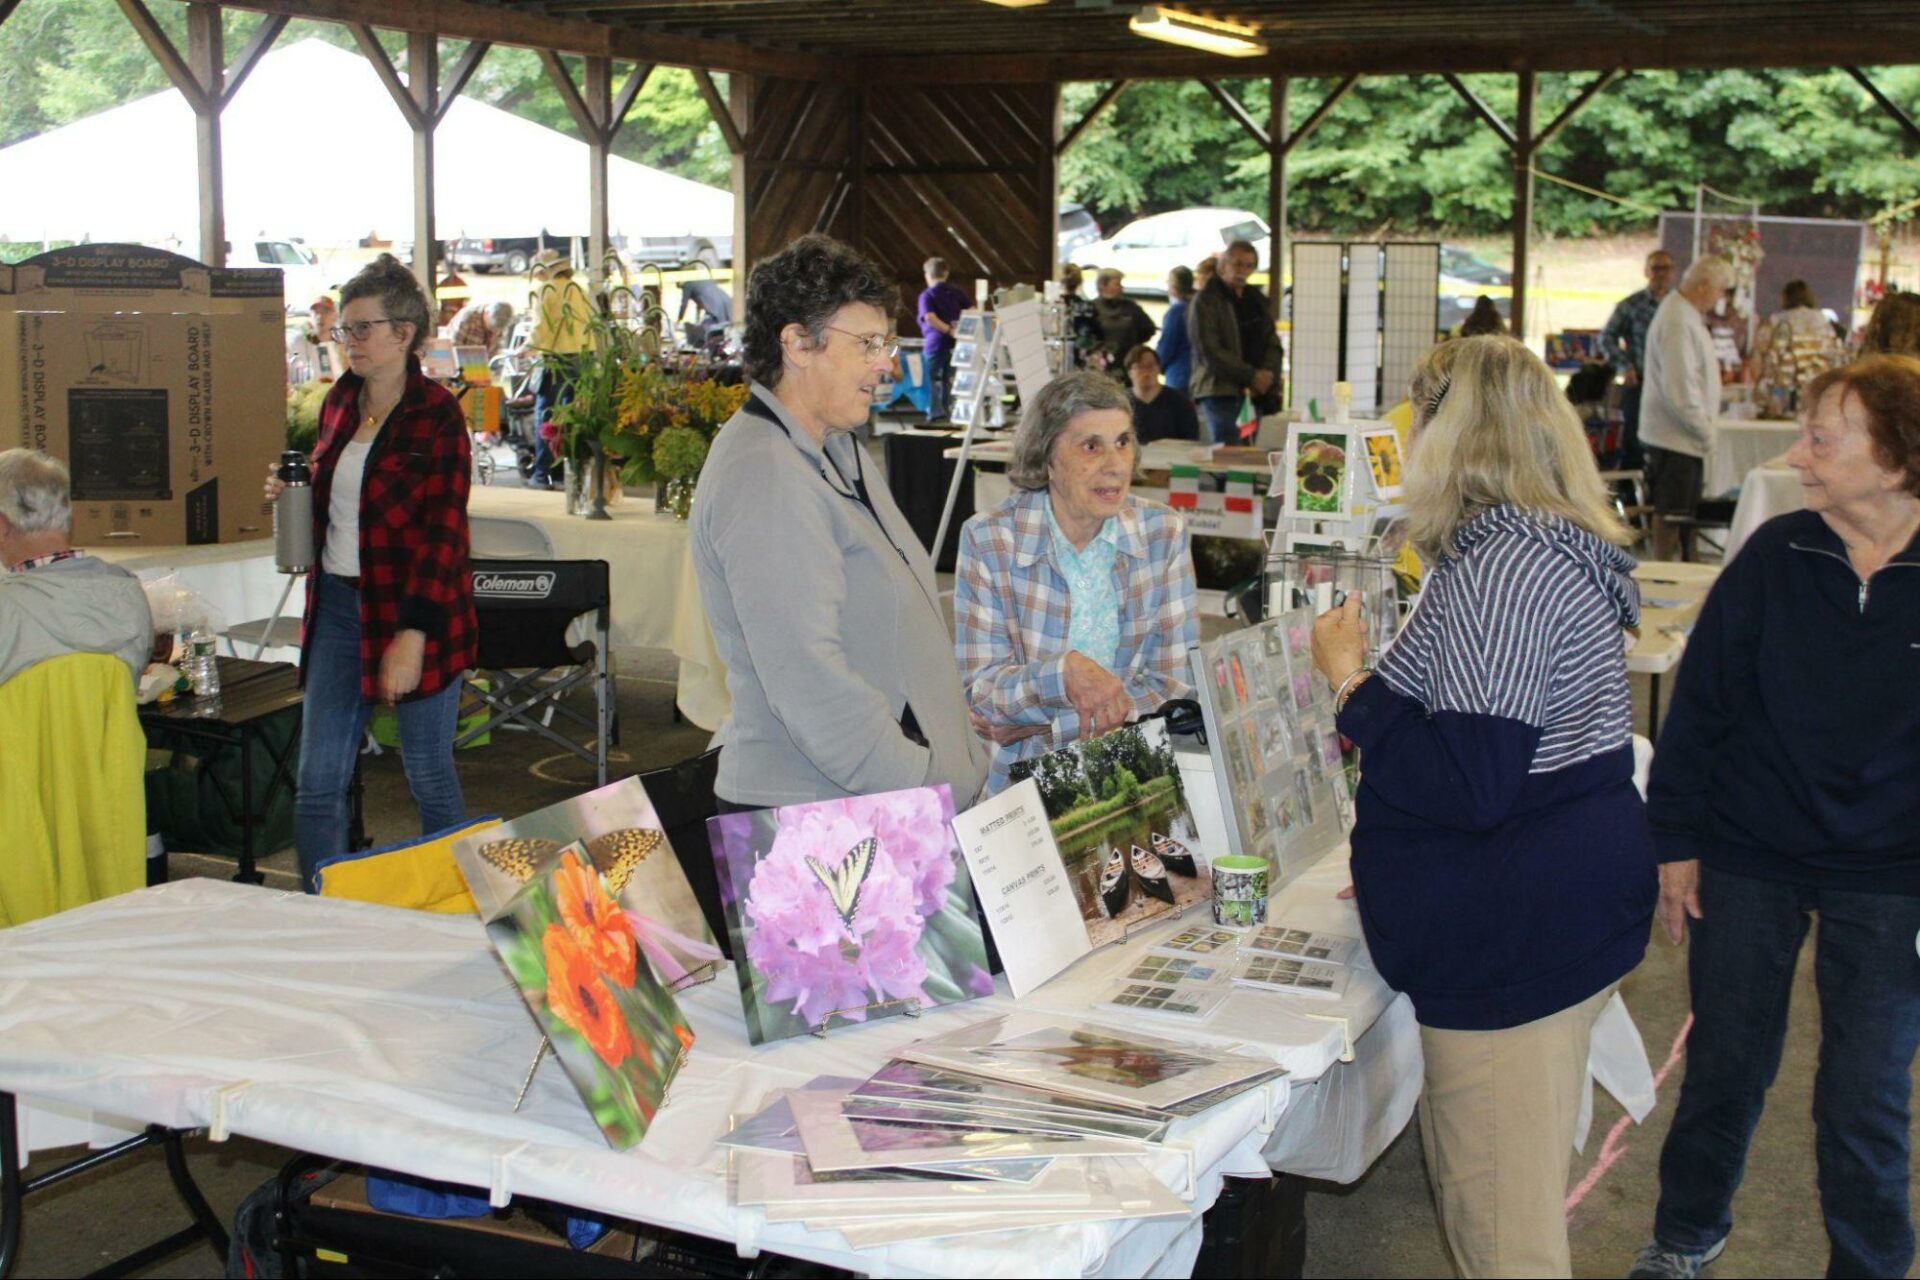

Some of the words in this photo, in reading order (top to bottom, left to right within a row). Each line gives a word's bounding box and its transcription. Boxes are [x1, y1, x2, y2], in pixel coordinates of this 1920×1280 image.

[187, 327, 199, 370] BOARD
[33, 371, 46, 420] DISPLAY
[188, 375, 200, 424] DISPLAY
[35, 424, 47, 453] BOA
[189, 428, 201, 453] 3-D
[474, 575, 534, 590] Coleman
[1001, 878, 1026, 895] CANVAS
[1026, 864, 1046, 879] PRINTS
